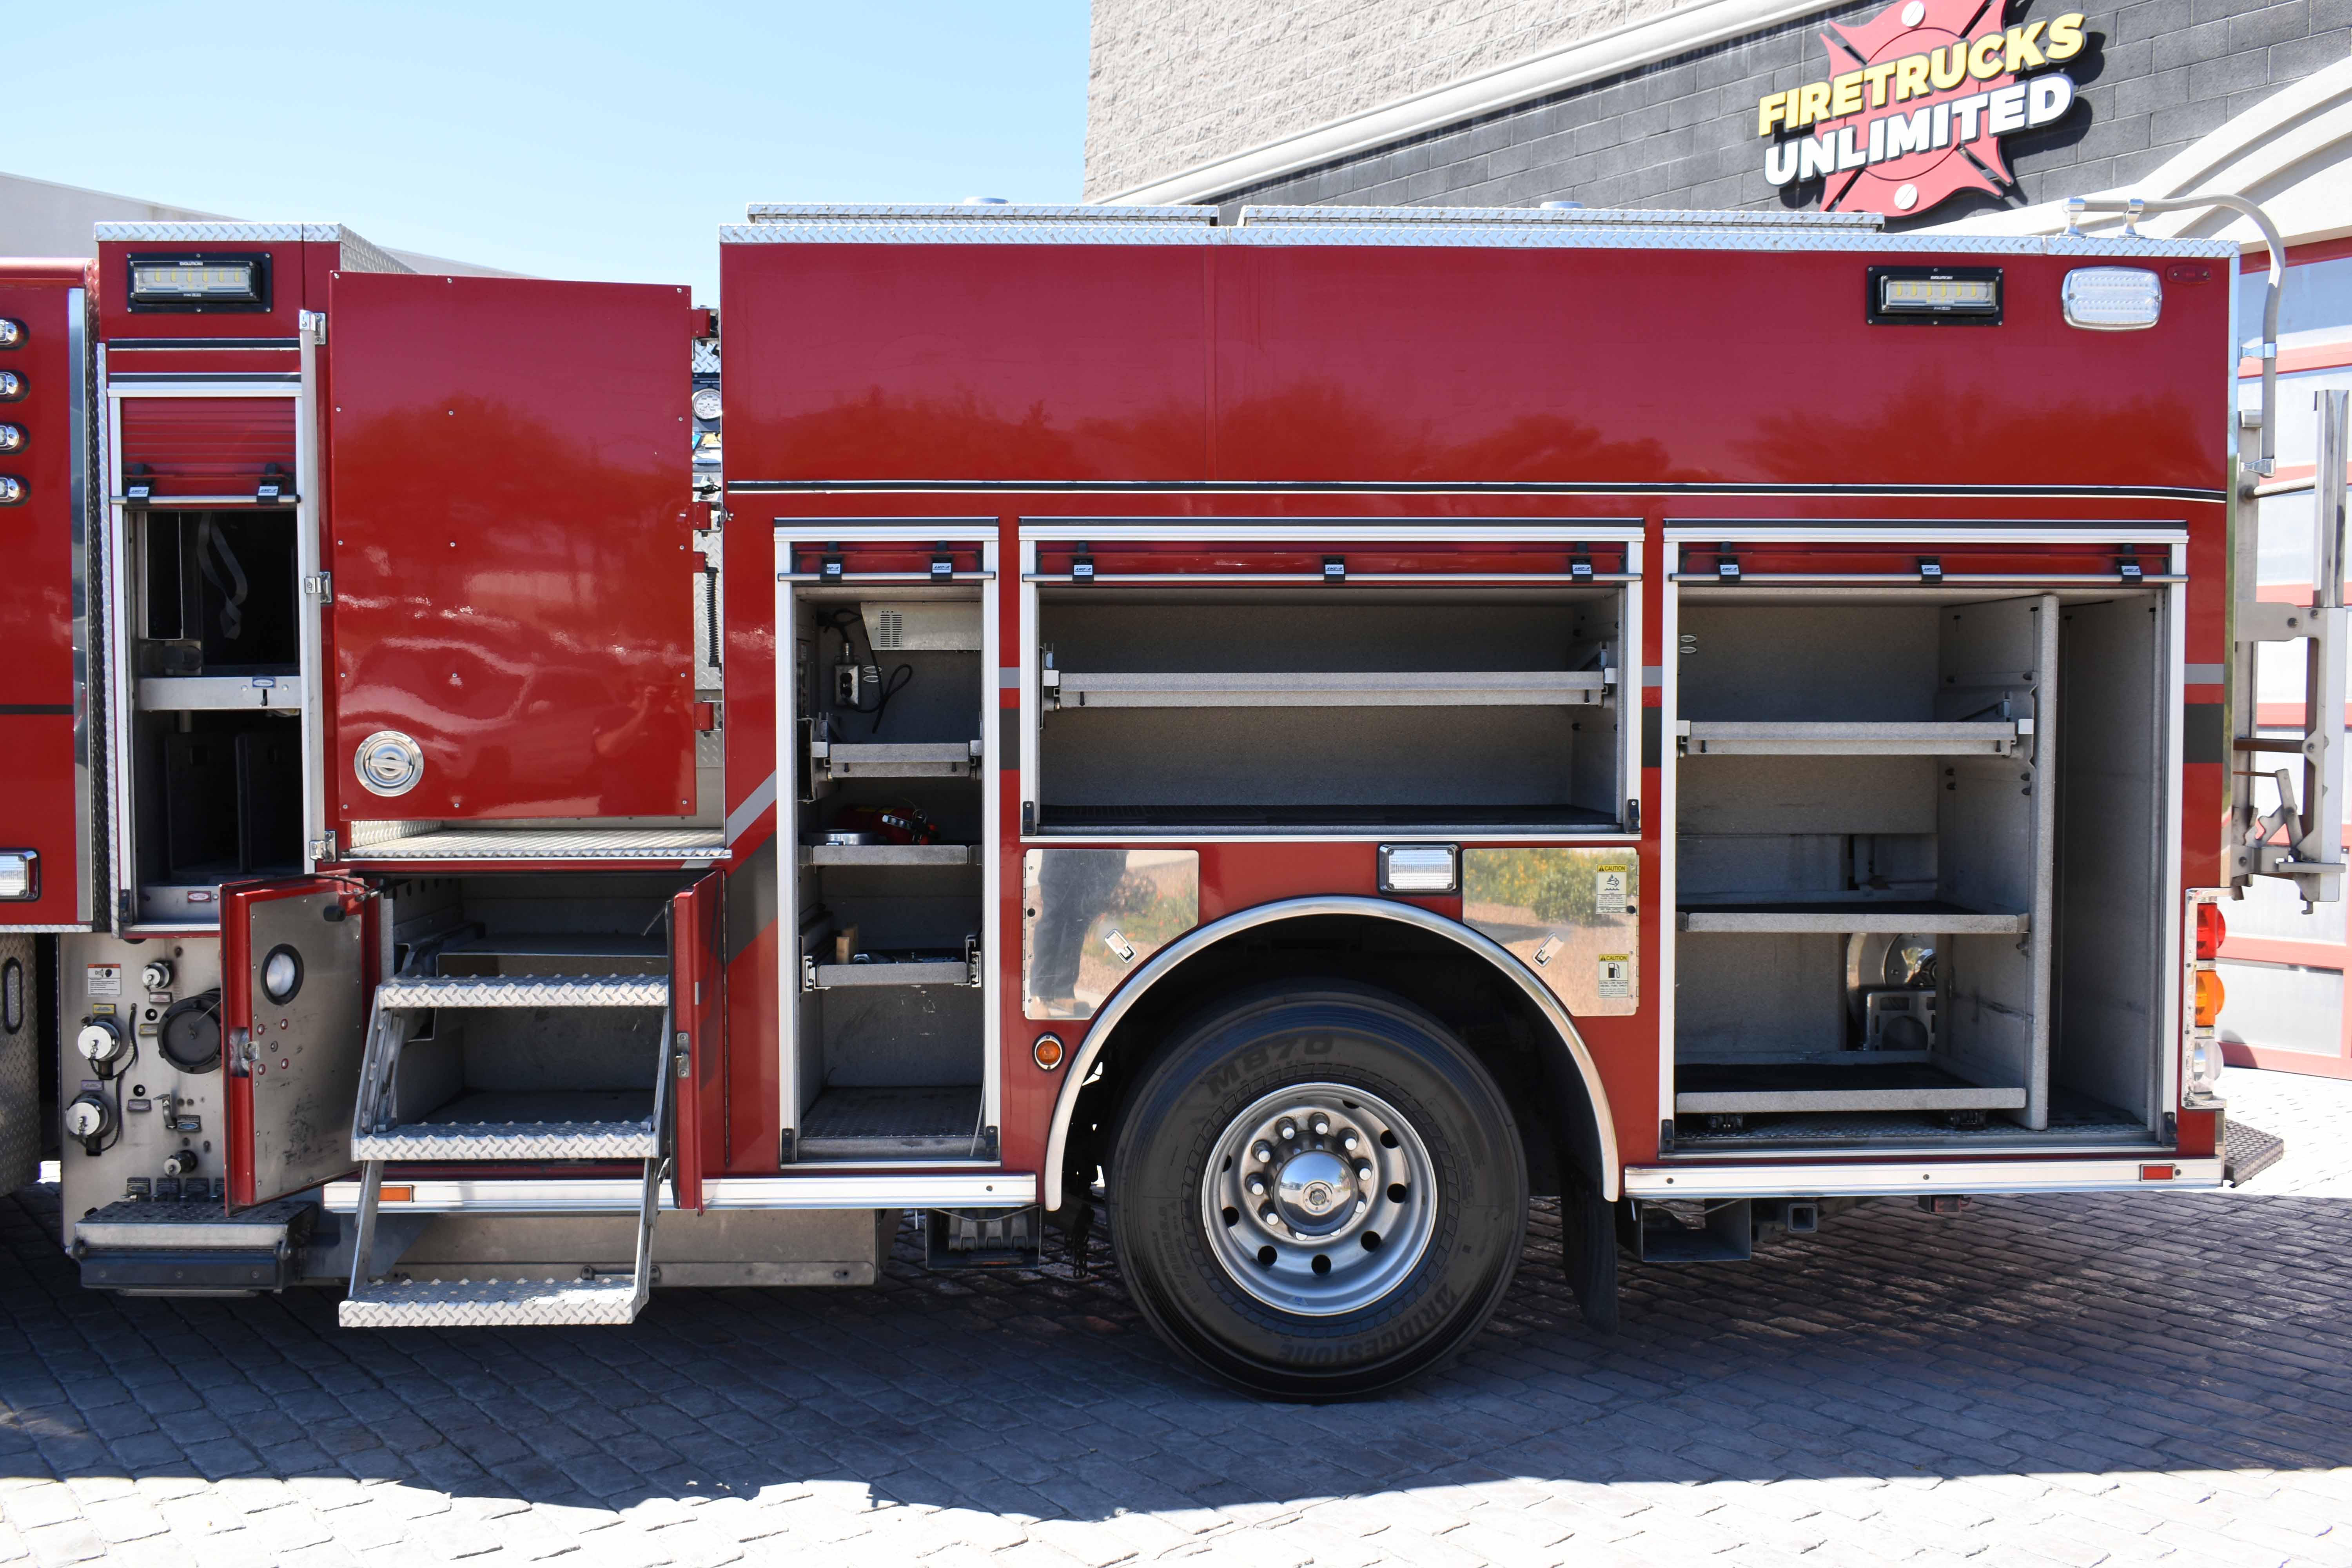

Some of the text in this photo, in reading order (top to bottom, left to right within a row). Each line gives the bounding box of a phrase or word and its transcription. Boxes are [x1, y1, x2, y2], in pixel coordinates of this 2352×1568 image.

[1759, 13, 2085, 136] FIRETRUCKS
[1765, 77, 2073, 185] UNLIMITED
[1207, 1037, 1334, 1096] M870
[1278, 1283, 1458, 1363] BRIDGESTONE
